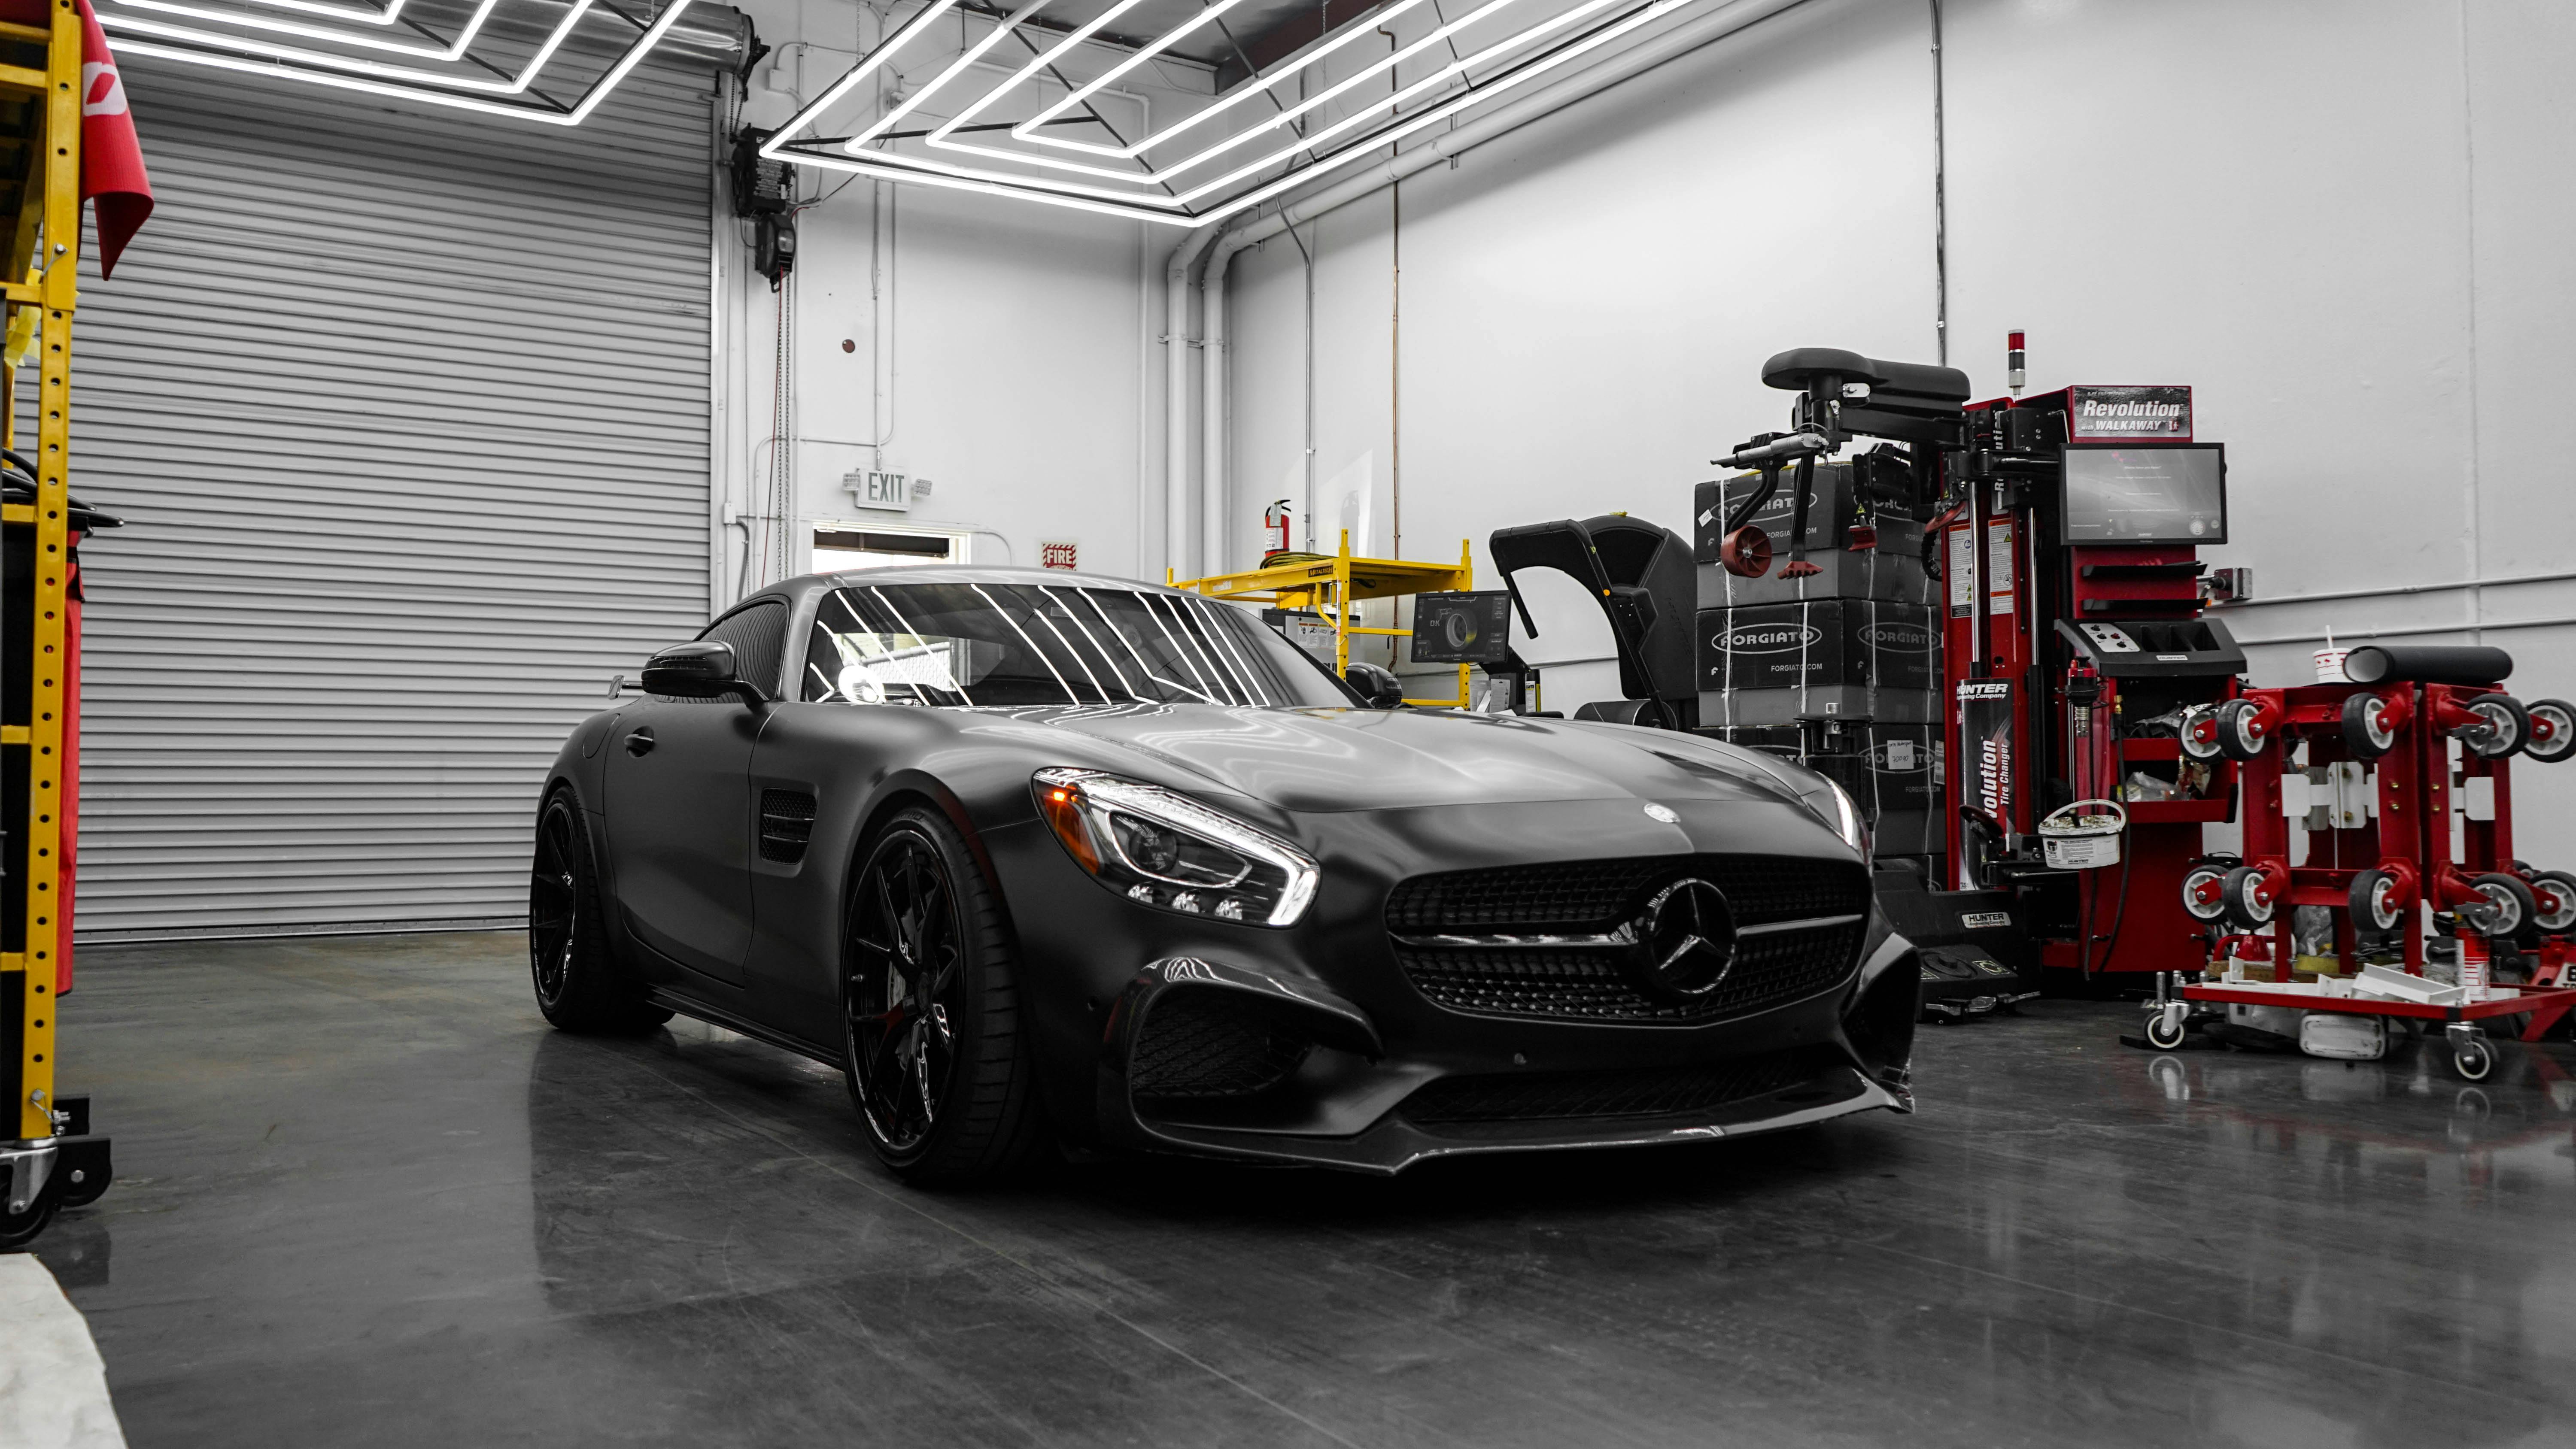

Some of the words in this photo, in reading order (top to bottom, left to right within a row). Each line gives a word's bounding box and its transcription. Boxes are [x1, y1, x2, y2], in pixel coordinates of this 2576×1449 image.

[2084, 400, 2180, 417] Revolution
[2096, 420, 2161, 430] WALKAWAY
[868, 473, 904, 503] EXIT
[1047, 549, 1072, 564] FIRE
[1956, 684, 2008, 694] HUNTER
[2000, 743, 2010, 784] Changer
[1980, 740, 1997, 818] volution
[2000, 786, 2009, 805] Tire
[1968, 913, 2004, 922] HUNTER
